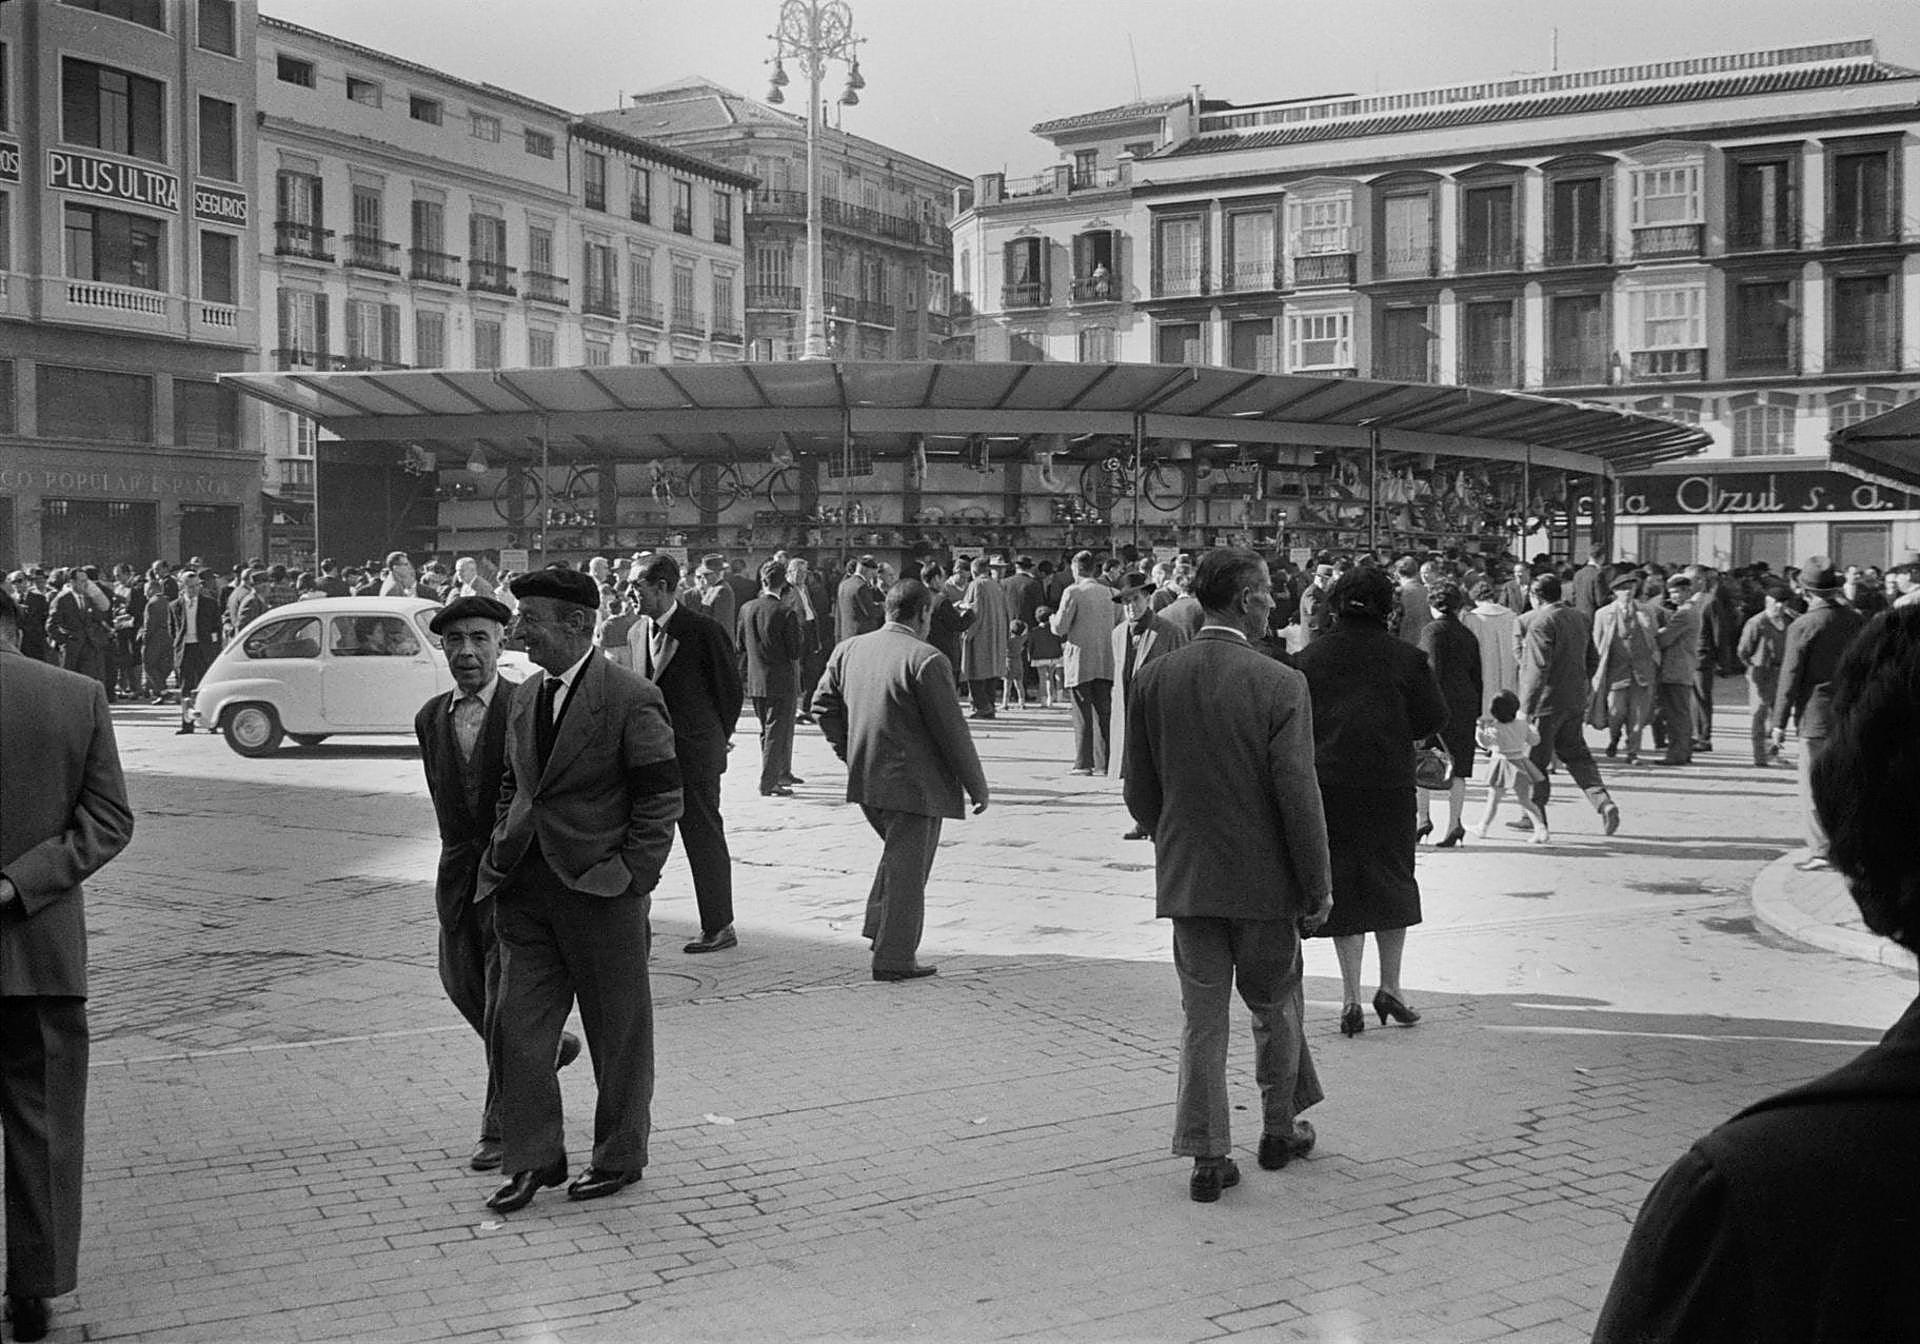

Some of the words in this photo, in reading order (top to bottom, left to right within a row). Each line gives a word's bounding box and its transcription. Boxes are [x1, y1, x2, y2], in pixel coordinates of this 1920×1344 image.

[50, 153, 113, 193] PLUS
[118, 165, 178, 210] ULTRA
[195, 191, 248, 220] SEGUROS
[44, 471, 145, 492] POPULAR
[1676, 474, 1784, 513] Azul
